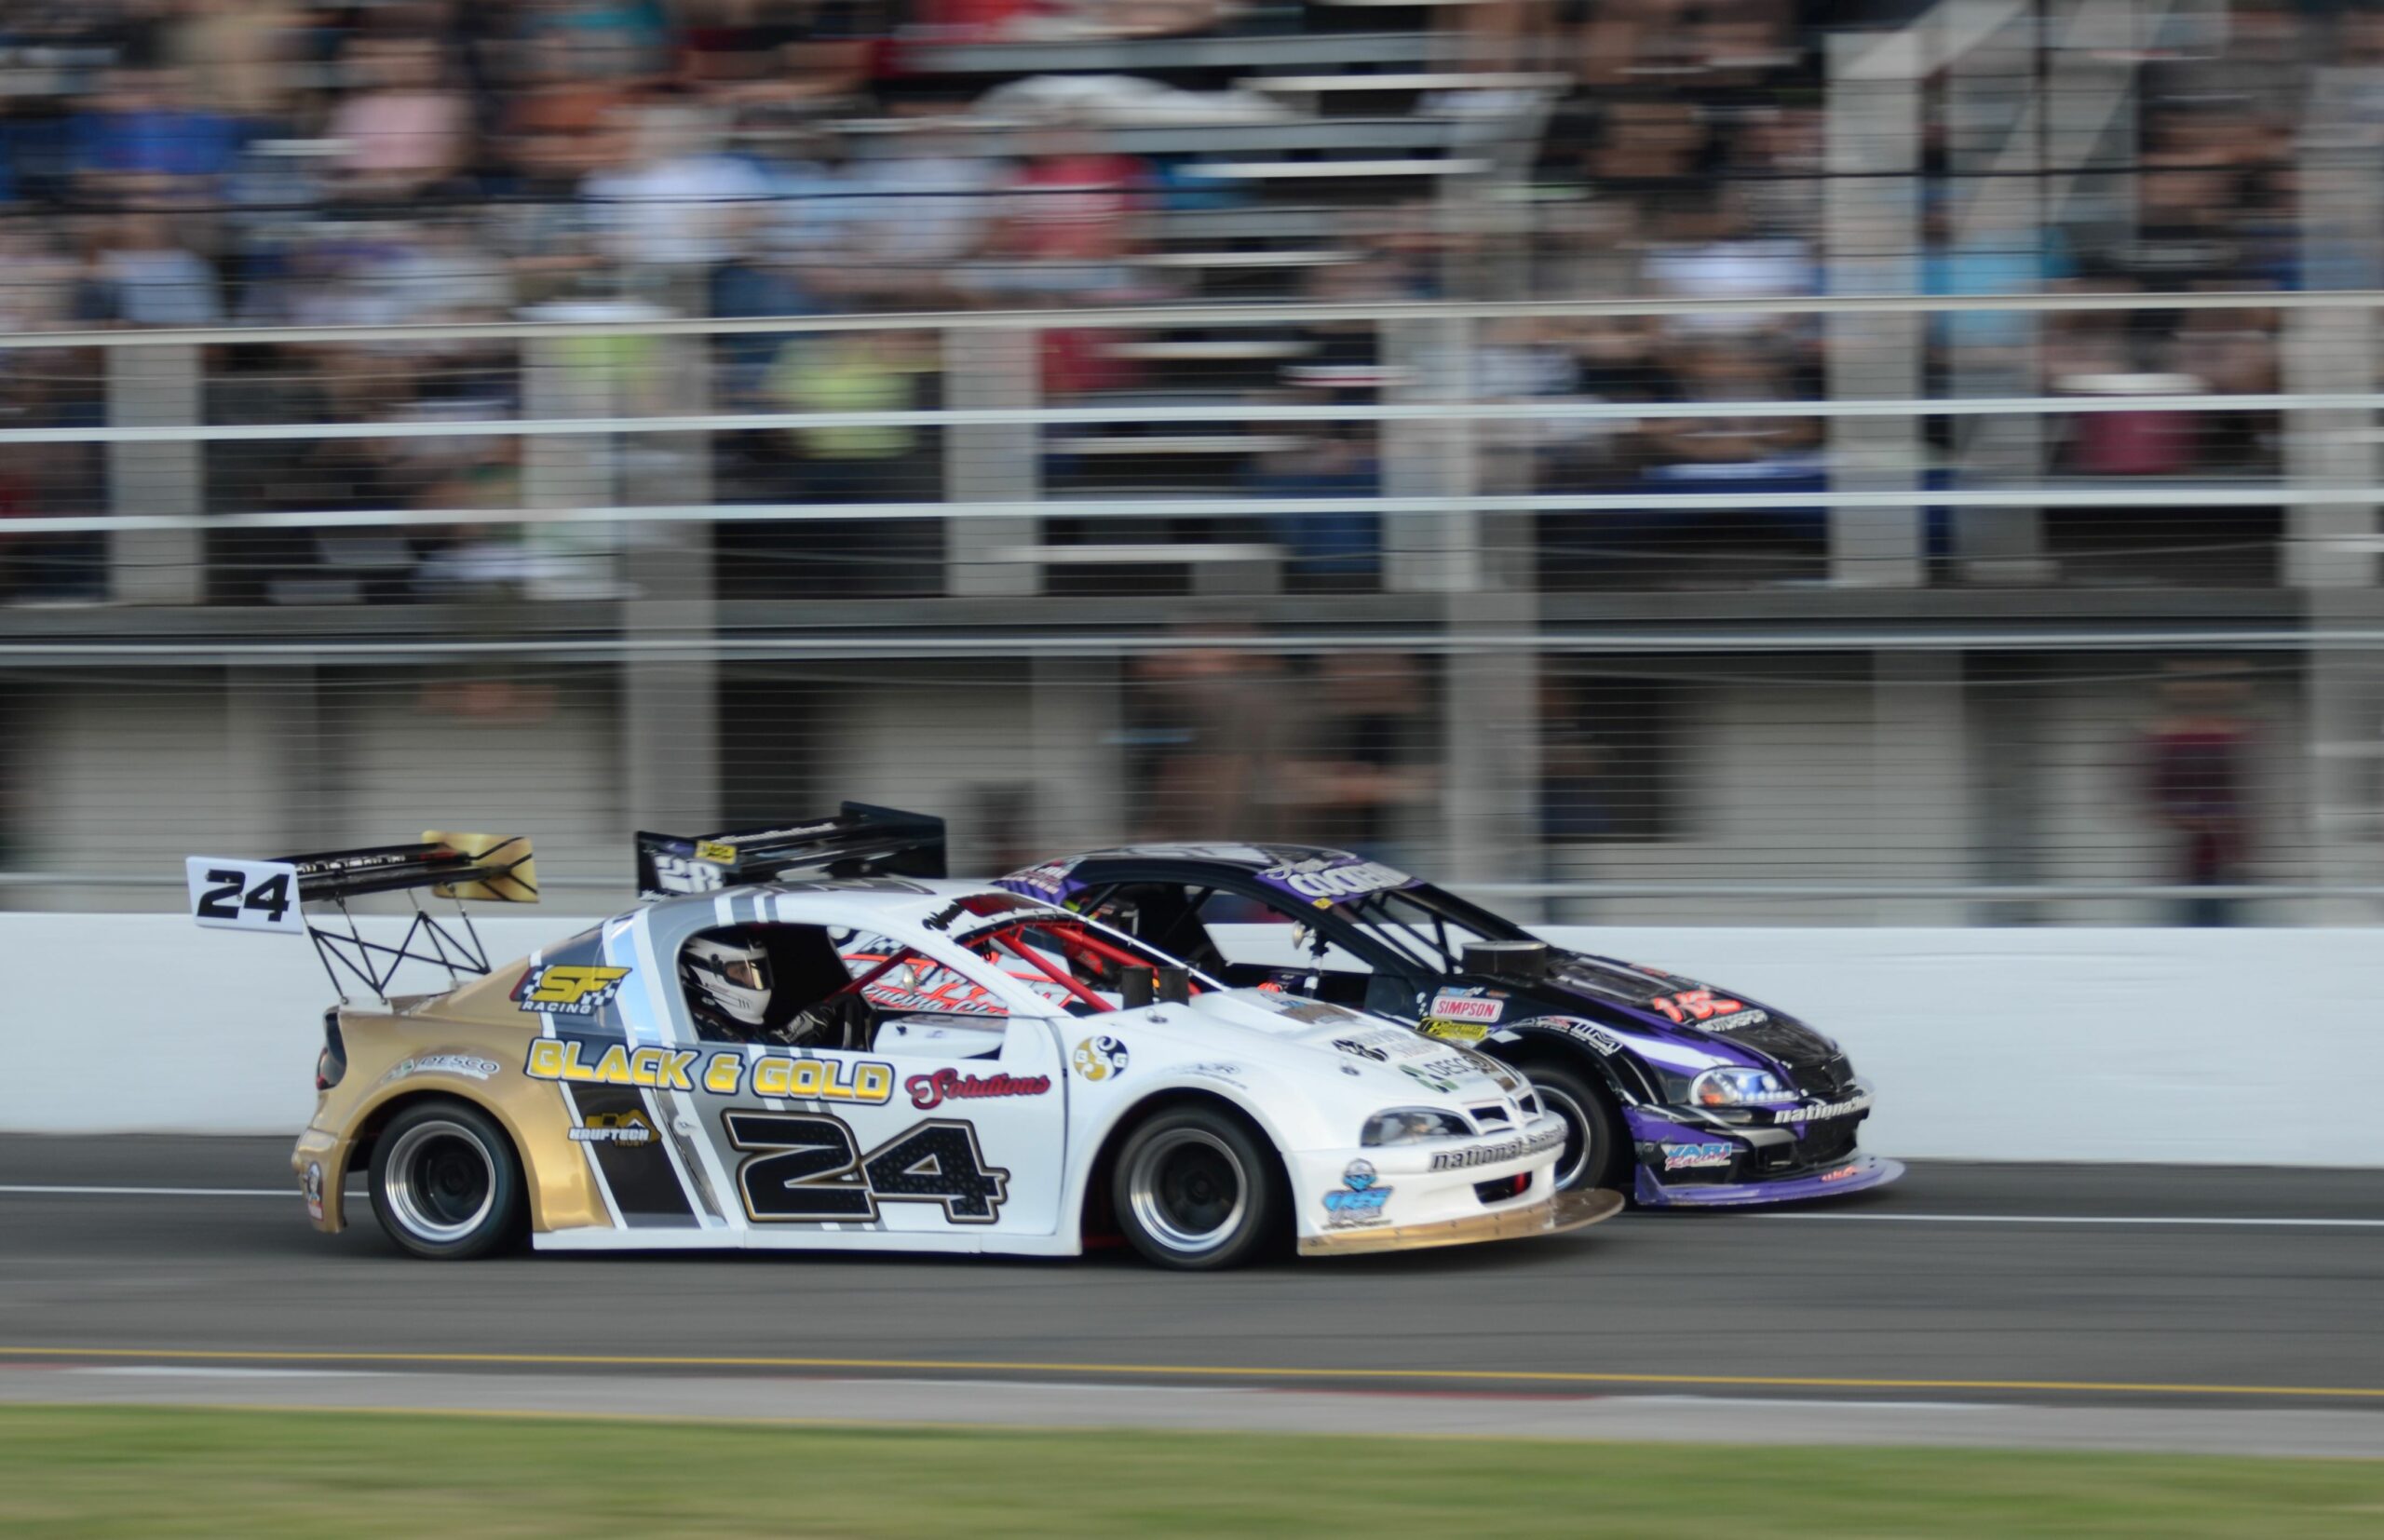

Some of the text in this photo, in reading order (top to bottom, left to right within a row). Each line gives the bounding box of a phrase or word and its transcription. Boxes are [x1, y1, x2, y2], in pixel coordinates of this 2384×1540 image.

[196, 869, 291, 922] 24
[530, 965, 631, 1003] SF
[522, 1001, 592, 1014] RACING
[1436, 999, 1496, 1018] SIMPSON
[526, 1039, 895, 1105] BLACK & GOLD
[904, 1068, 1050, 1110] Solutions
[721, 1108, 1010, 1224] 24
[1430, 1137, 1523, 1170] national
